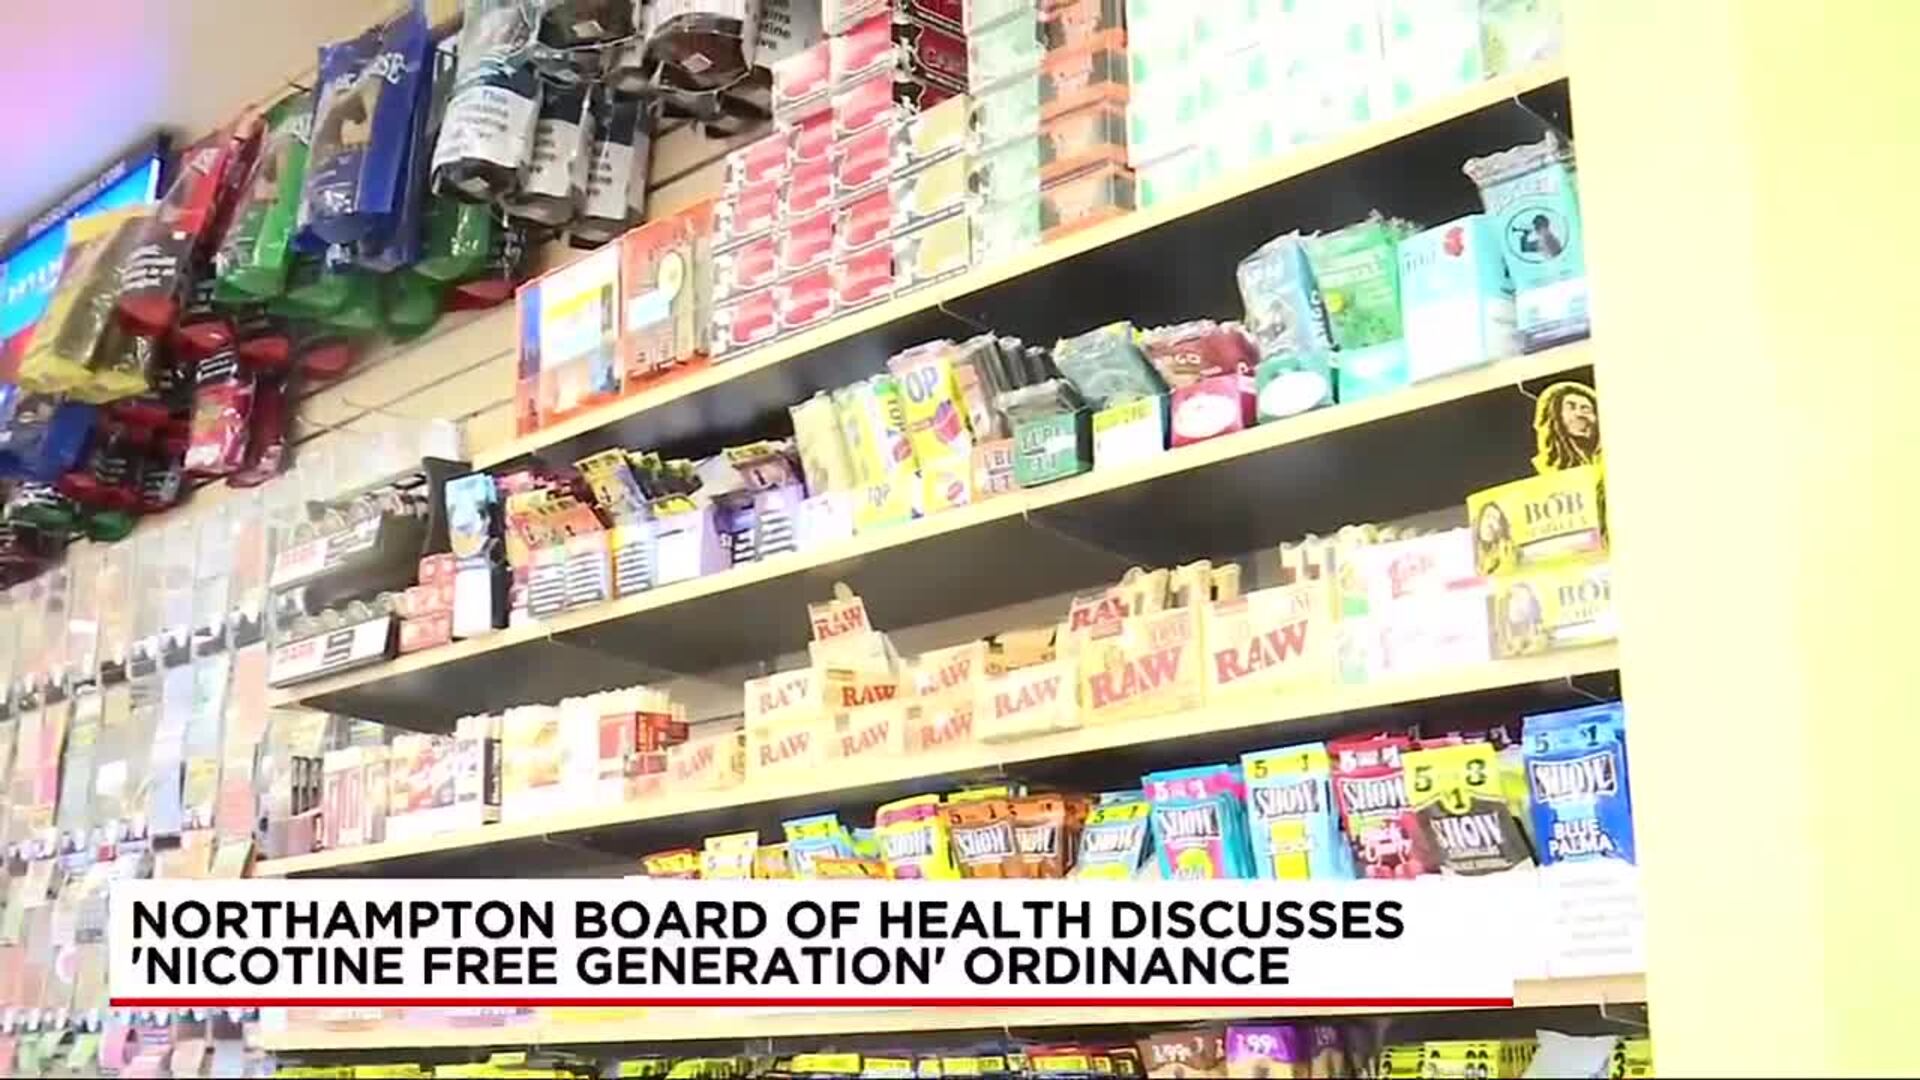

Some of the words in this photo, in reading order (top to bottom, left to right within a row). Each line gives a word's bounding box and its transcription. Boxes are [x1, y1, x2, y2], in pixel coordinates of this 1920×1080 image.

[905, 364, 940, 404] OP
[1524, 491, 1585, 526] BOB
[813, 604, 865, 642] RAW
[1213, 619, 1309, 685] RAW
[759, 677, 809, 715] RAW
[840, 684, 898, 708] RAW
[1088, 645, 1184, 710] RAW
[993, 674, 1062, 720] RAW
[759, 731, 811, 768] RAW
[840, 719, 890, 758] RAW
[919, 711, 974, 751] RAW
[1414, 765, 1433, 792] 5
[1430, 813, 1504, 850] SHOW
[1548, 832, 1615, 857] PALMA
[1553, 818, 1601, 838] BLUE
